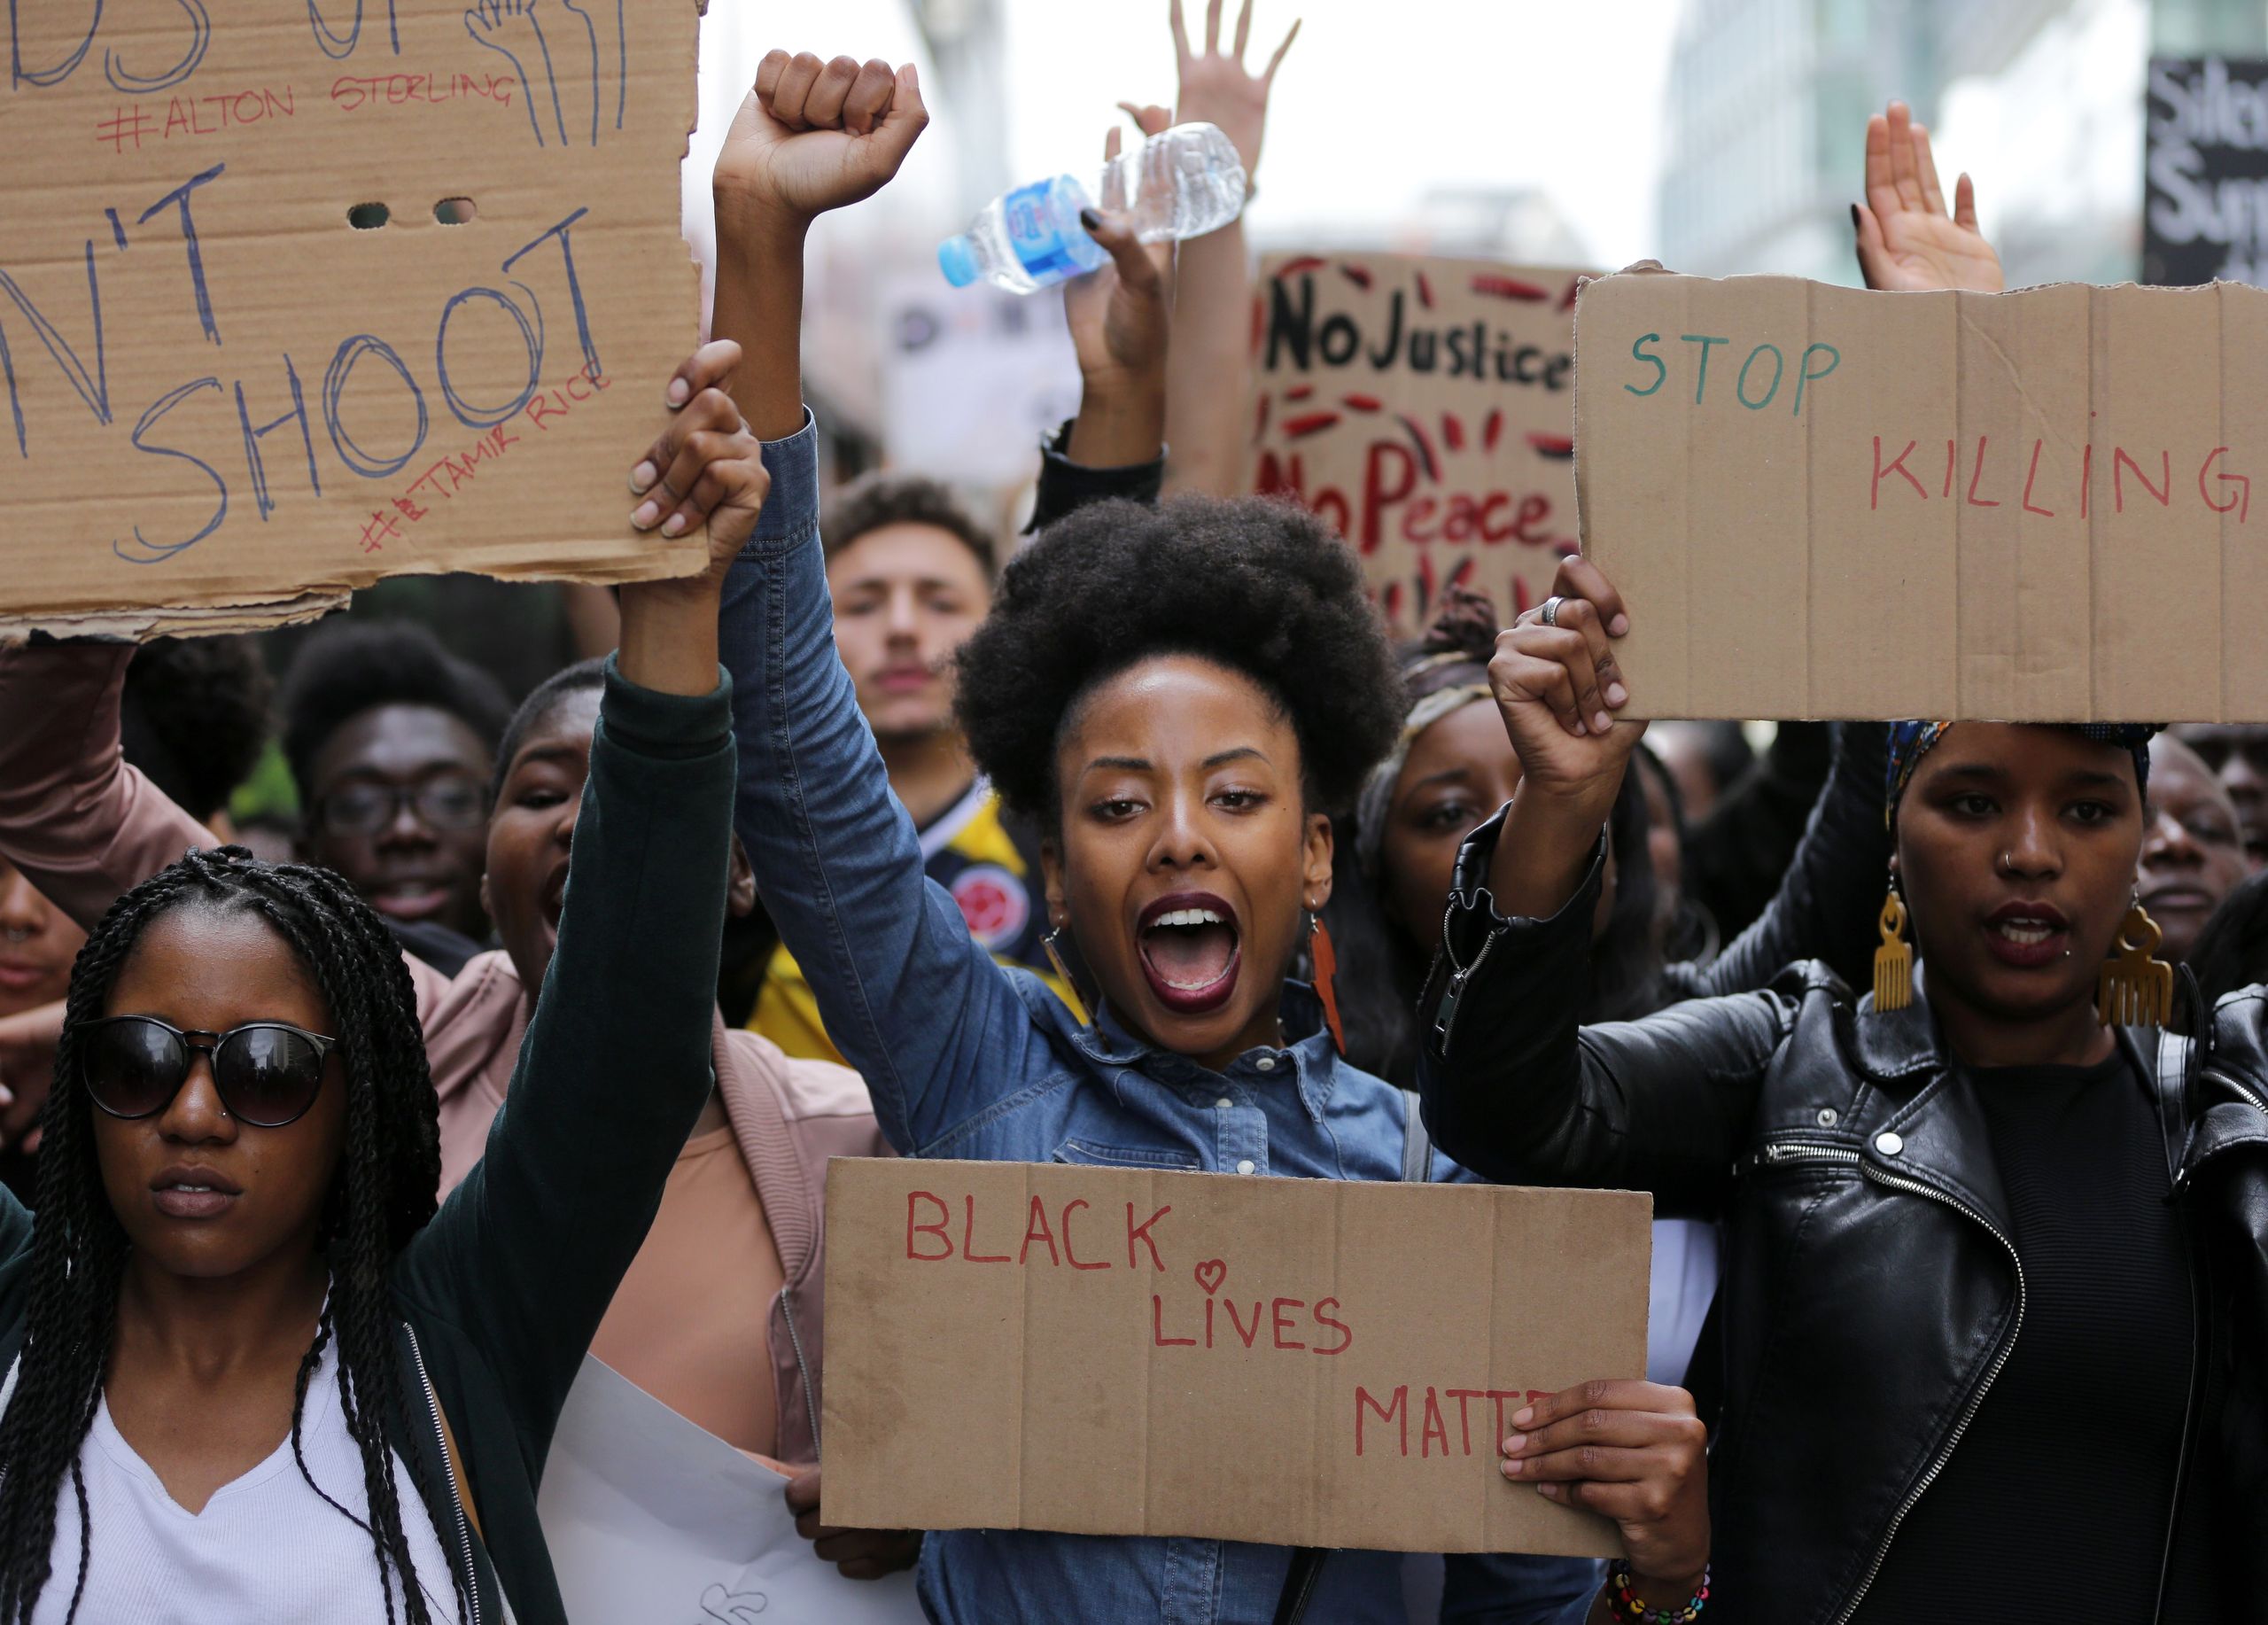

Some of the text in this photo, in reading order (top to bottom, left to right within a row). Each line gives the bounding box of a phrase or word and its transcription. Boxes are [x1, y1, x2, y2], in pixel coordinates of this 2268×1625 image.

[96, 73, 516, 154] #ALTON STERLING
[1264, 272, 1572, 391] No Justice
[113, 206, 603, 564] SHOOT
[525, 358, 611, 431] RICE
[1624, 332, 1841, 416] STOP
[1359, 439, 1551, 558] Peace
[1870, 435, 2251, 524] KILLING
[906, 1190, 1172, 1272] BLACK
[1152, 1293, 1352, 1356] LIVES
[1355, 1385, 1559, 1458] MATT
